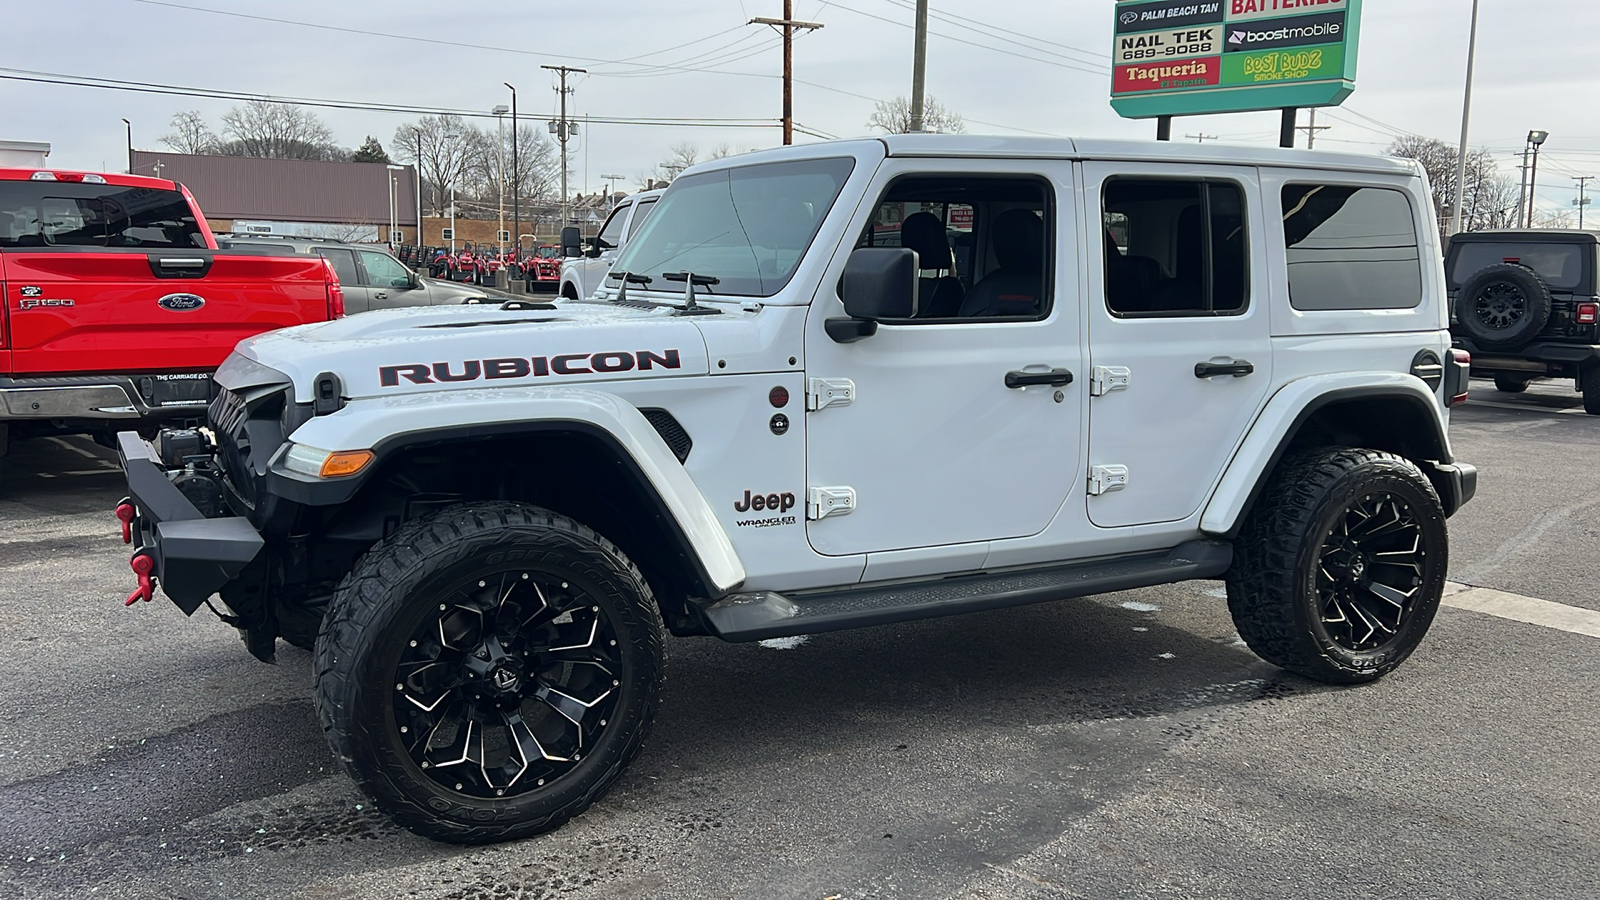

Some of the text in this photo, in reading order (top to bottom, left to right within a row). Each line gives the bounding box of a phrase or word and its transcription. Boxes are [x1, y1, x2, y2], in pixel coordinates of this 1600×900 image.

[1141, 2, 1219, 21] PALM BEACH TAN
[1121, 28, 1213, 49] NAIL TEK
[1123, 42, 1212, 60] 689-9088
[1254, 70, 1309, 81] SMOKE SHOP
[170, 296, 195, 307] Ford
[169, 373, 198, 381] CARRIAGE
[379, 349, 681, 387] RUBICON
[734, 489, 796, 514] Jeep
[736, 515, 796, 527] WRANGLER
